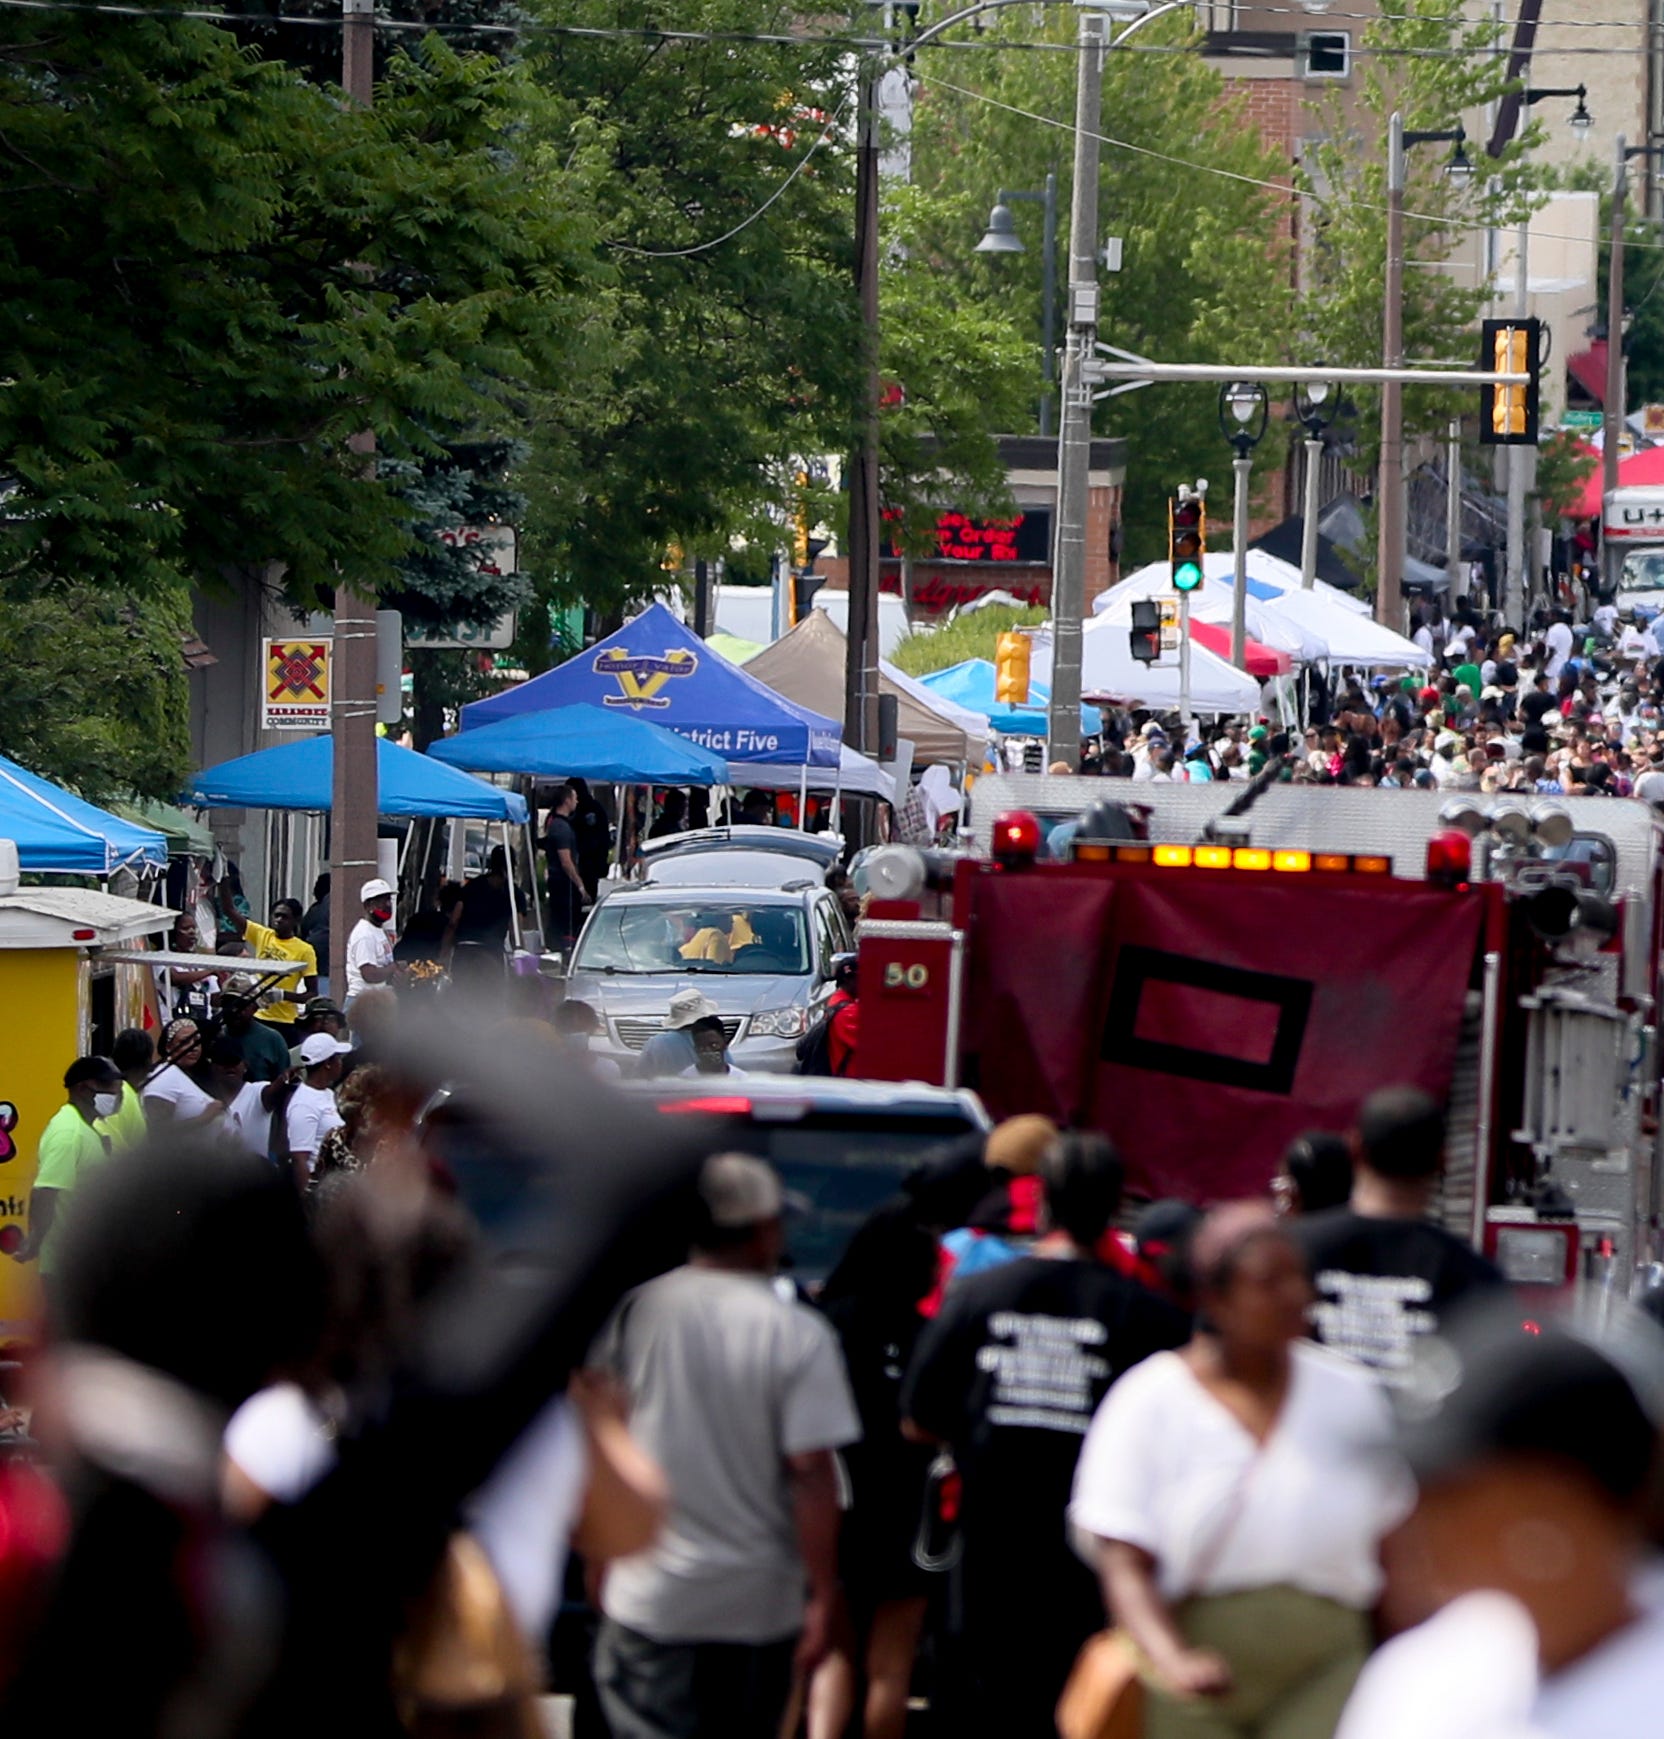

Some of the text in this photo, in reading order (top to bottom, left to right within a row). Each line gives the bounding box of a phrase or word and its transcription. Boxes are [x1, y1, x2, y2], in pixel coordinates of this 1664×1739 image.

[959, 526, 1017, 545] Order
[940, 543, 985, 560] Your
[736, 730, 779, 751] Five
[884, 962, 929, 989] 50
